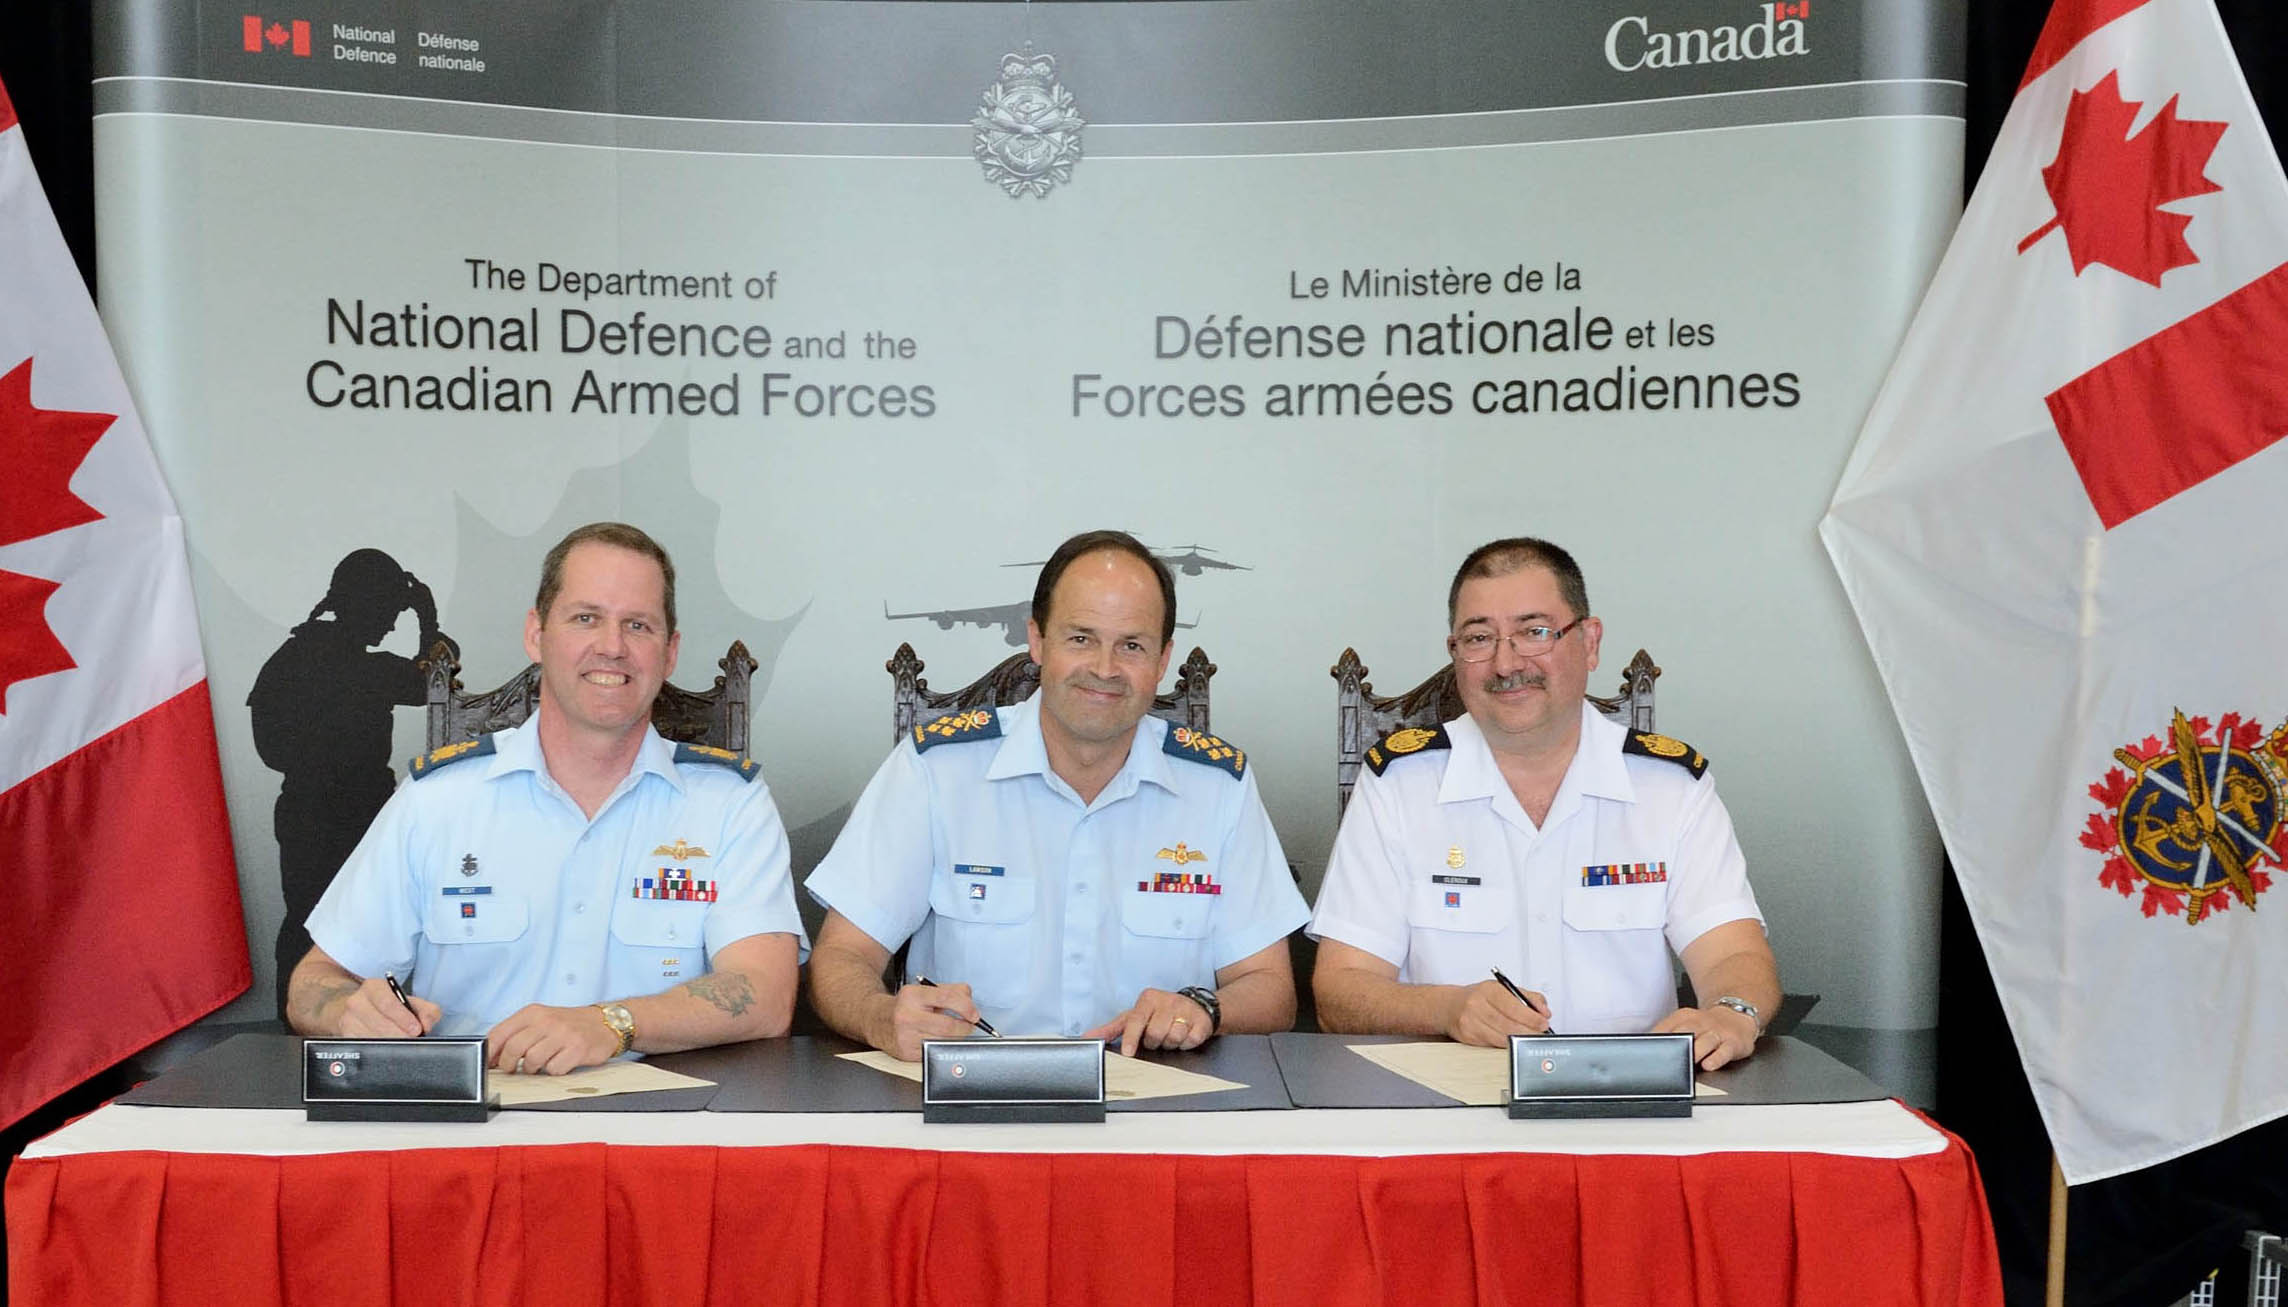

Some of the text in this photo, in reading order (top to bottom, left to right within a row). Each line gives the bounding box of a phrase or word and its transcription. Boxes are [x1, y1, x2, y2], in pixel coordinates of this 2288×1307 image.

[333, 23, 396, 46] National
[333, 45, 397, 65] Defence
[417, 31, 479, 52] Défense
[1604, 3, 1809, 72] Canada
[418, 54, 486, 73] nationale
[464, 258, 777, 301] The Department of
[1290, 261, 1582, 300] Le Ministère de la
[326, 298, 917, 360] National Defence and the
[1156, 306, 1716, 360] Défense nationale et les
[306, 359, 937, 419] Canadian Armed Forces
[1073, 365, 1802, 419] Forces armées canadiennes
